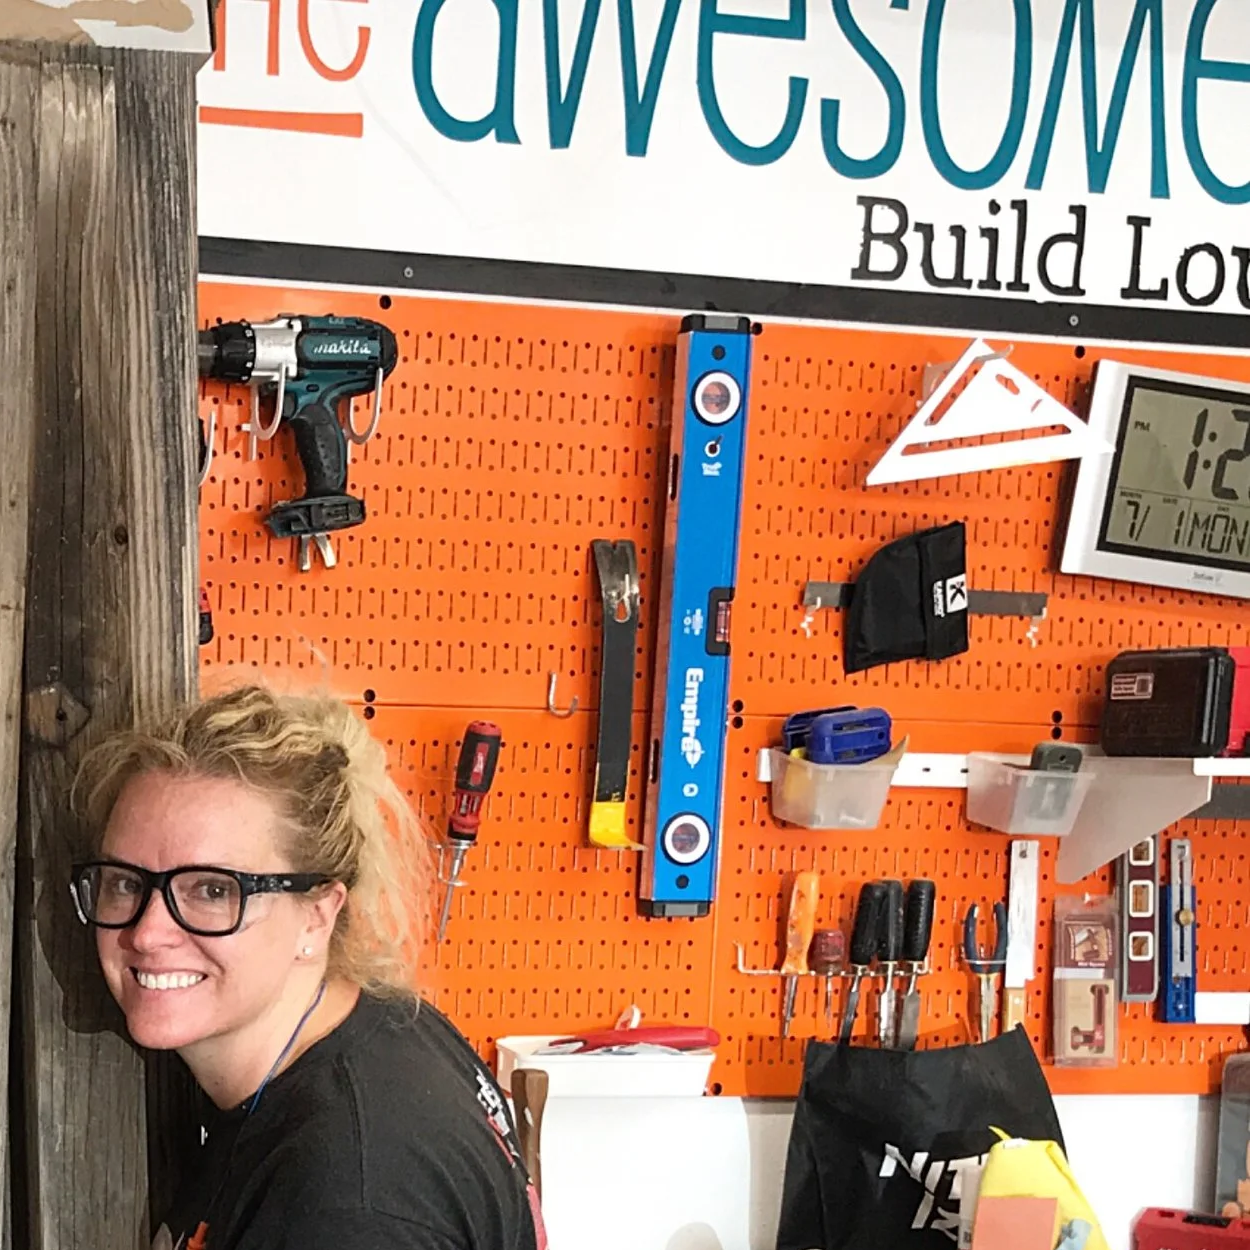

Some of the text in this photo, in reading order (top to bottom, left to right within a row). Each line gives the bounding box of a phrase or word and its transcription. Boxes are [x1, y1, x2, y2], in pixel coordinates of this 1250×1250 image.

[851, 195, 1087, 297] Build
[313, 339, 371, 355] makita
[1134, 407, 1250, 501] PM 1:2
[1187, 512, 1249, 556] MON
[680, 667, 705, 754] Empire
